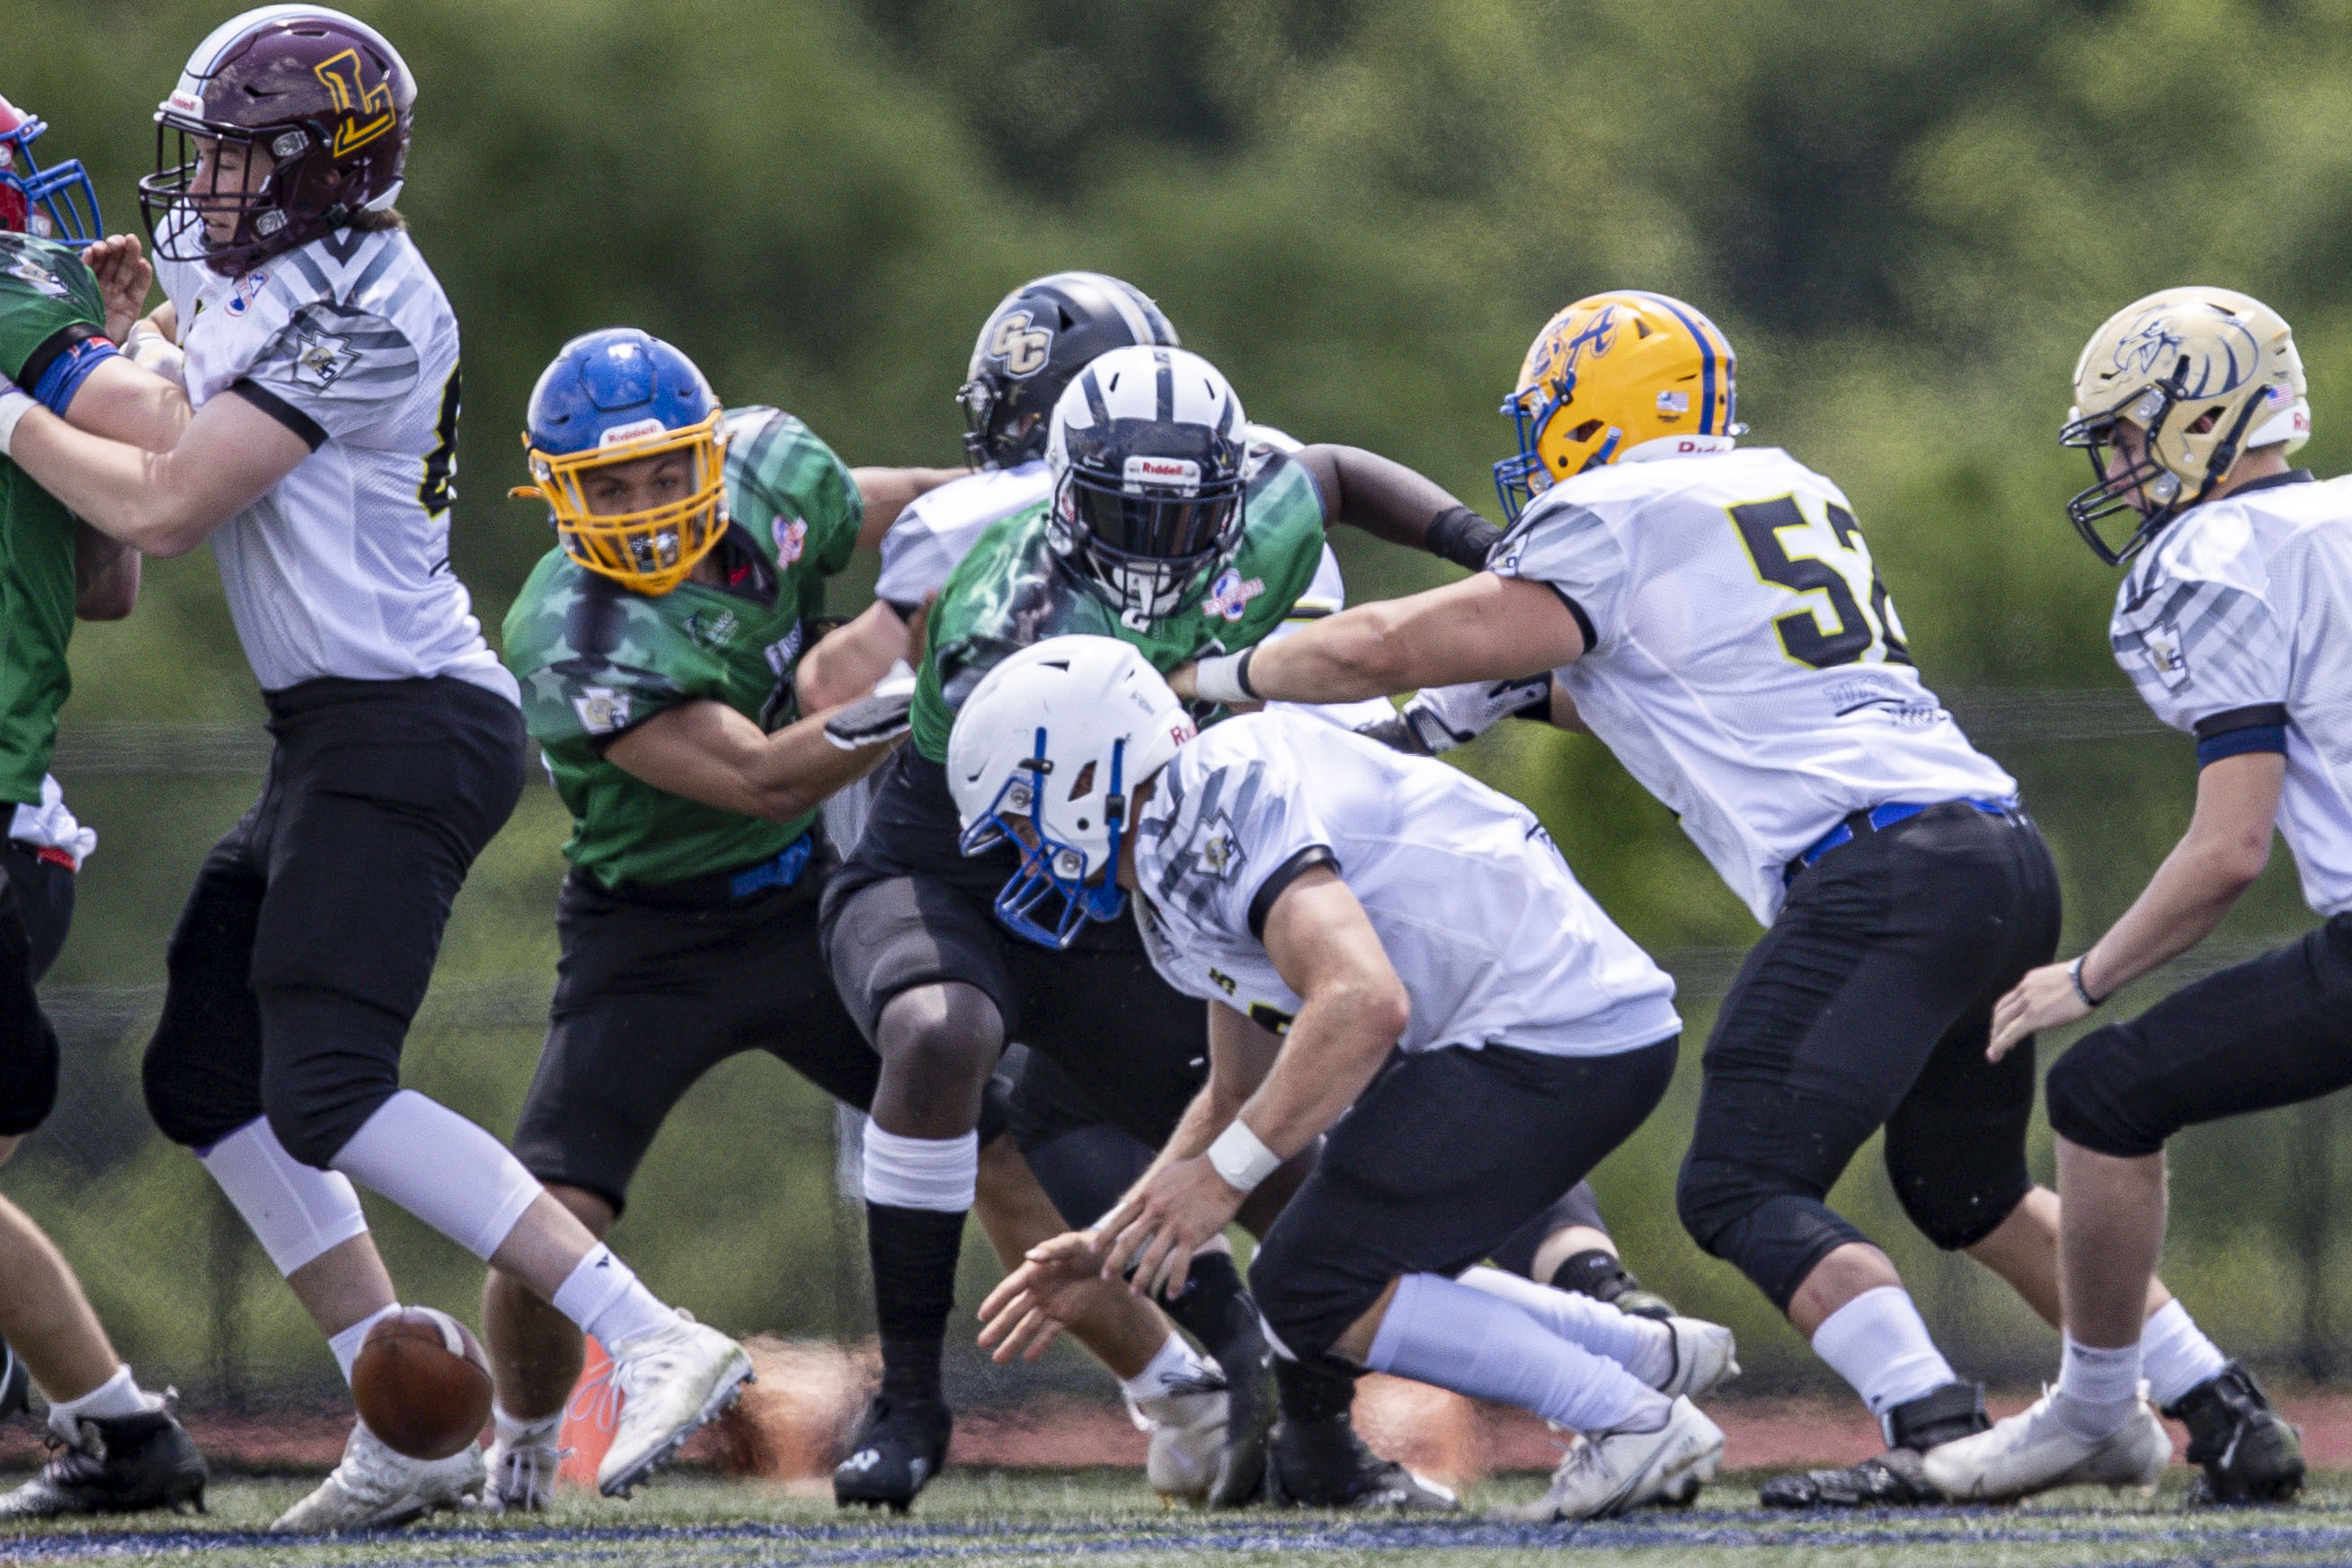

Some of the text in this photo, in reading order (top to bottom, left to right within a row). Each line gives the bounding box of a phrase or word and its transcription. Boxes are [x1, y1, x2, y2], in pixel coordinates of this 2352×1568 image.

[314, 48, 396, 158] L
[1142, 462, 1183, 475] Riddell
[1723, 492, 1913, 671] 52
